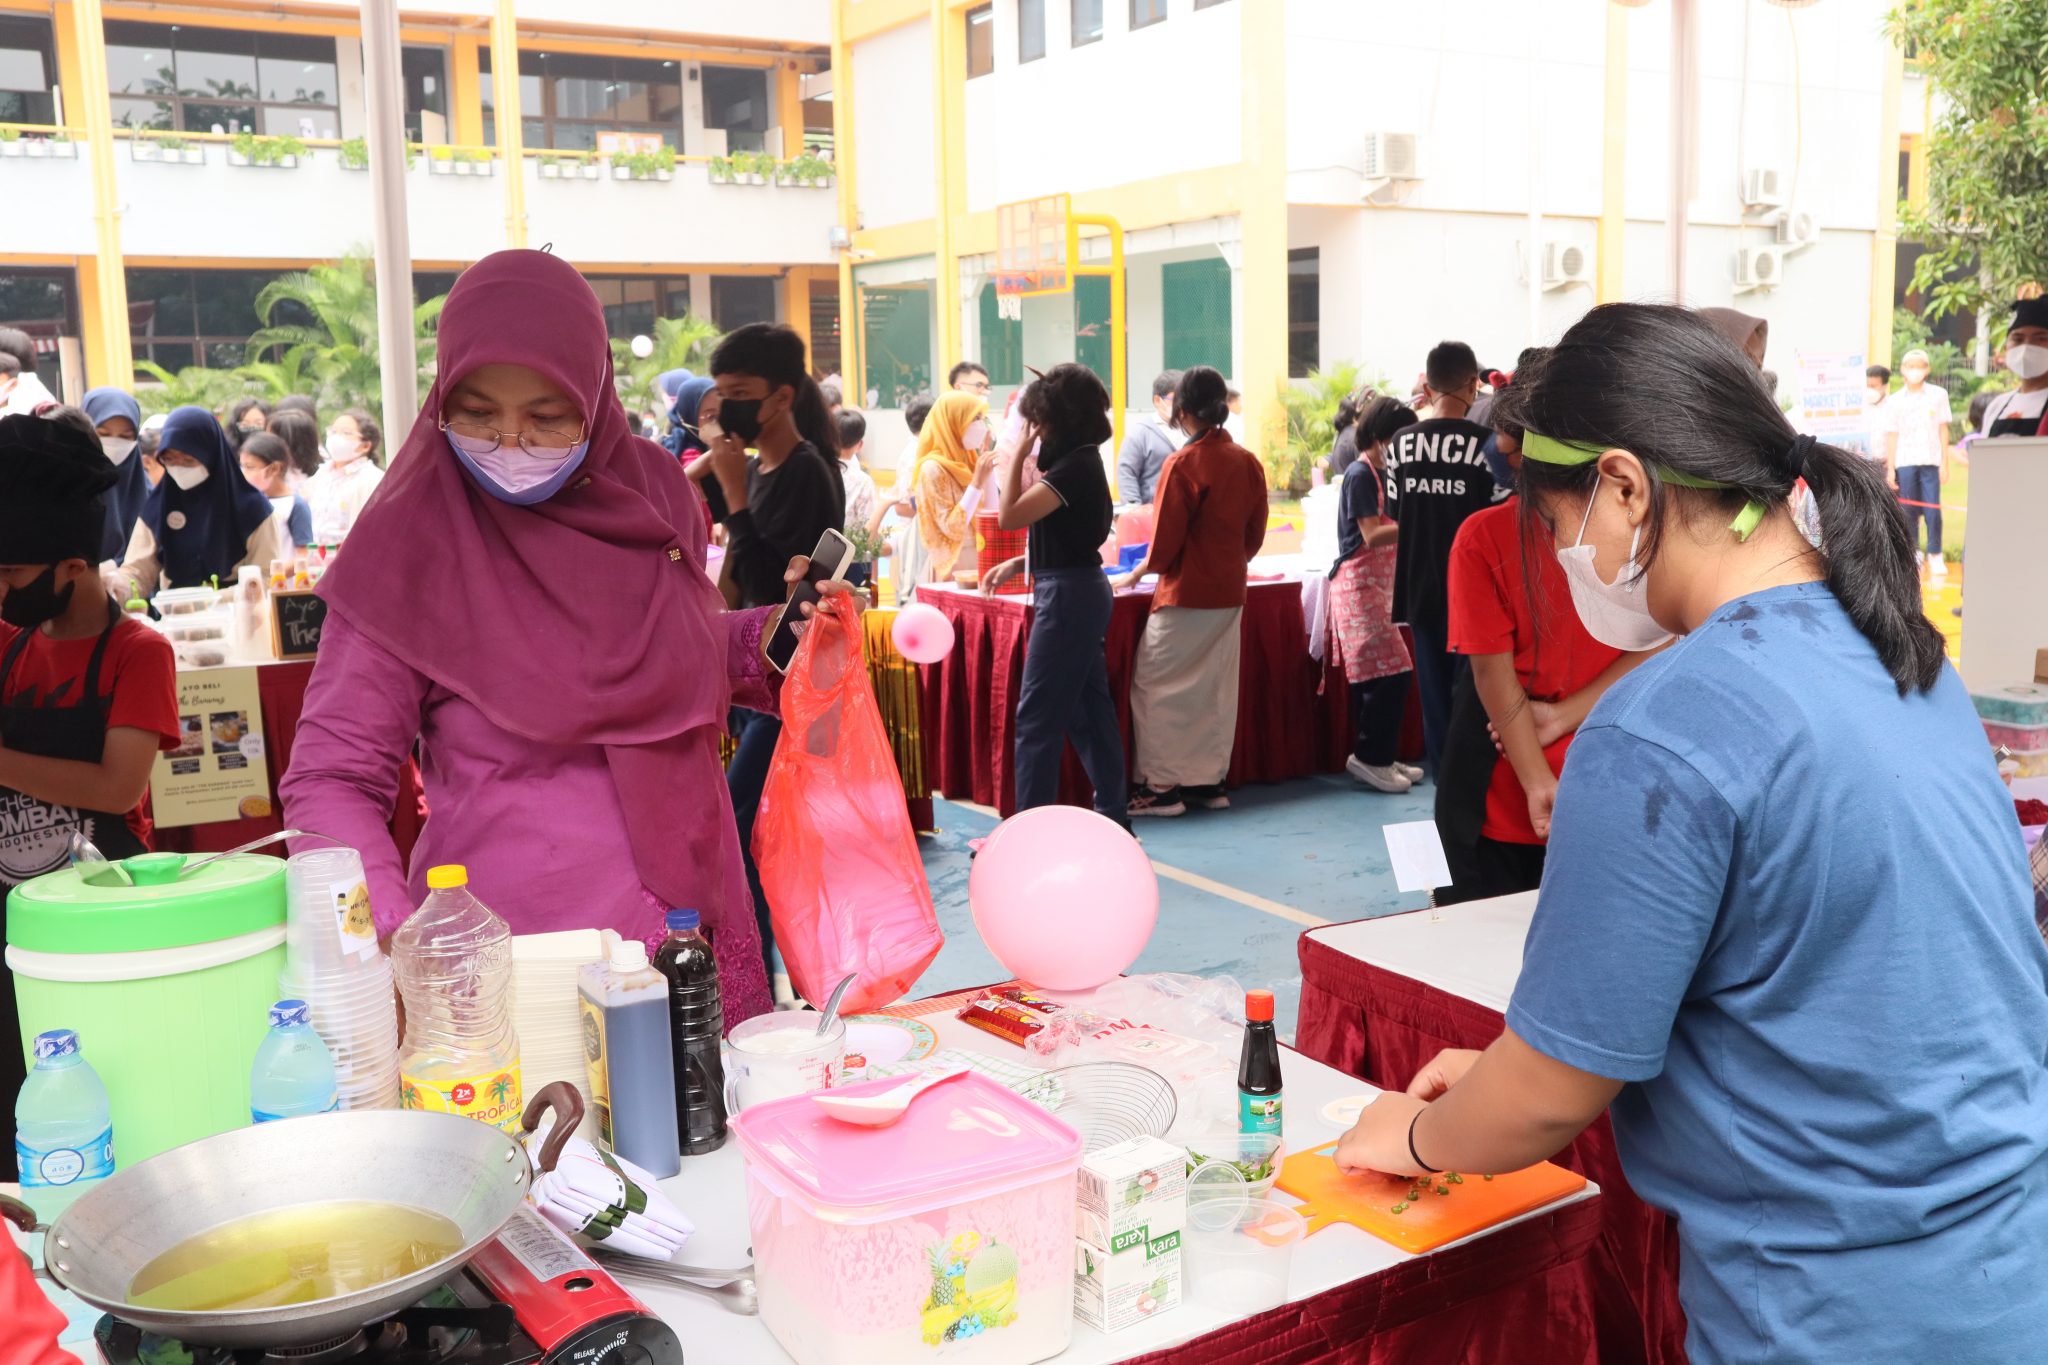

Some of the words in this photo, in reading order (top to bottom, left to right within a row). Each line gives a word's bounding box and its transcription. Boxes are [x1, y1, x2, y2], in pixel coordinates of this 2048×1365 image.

[1803, 392, 1841, 408] MARKET
[1845, 391, 1863, 406] DAY
[1405, 478, 1466, 495] PARIS
[285, 597, 317, 623] Ayo
[285, 620, 320, 646] The
[456, 1089, 471, 1099] 2x
[1116, 1229, 1146, 1250] kara
[1149, 1236, 1178, 1256] kara
[616, 1331, 629, 1339] OFF
[574, 1348, 596, 1360] RELEASE
